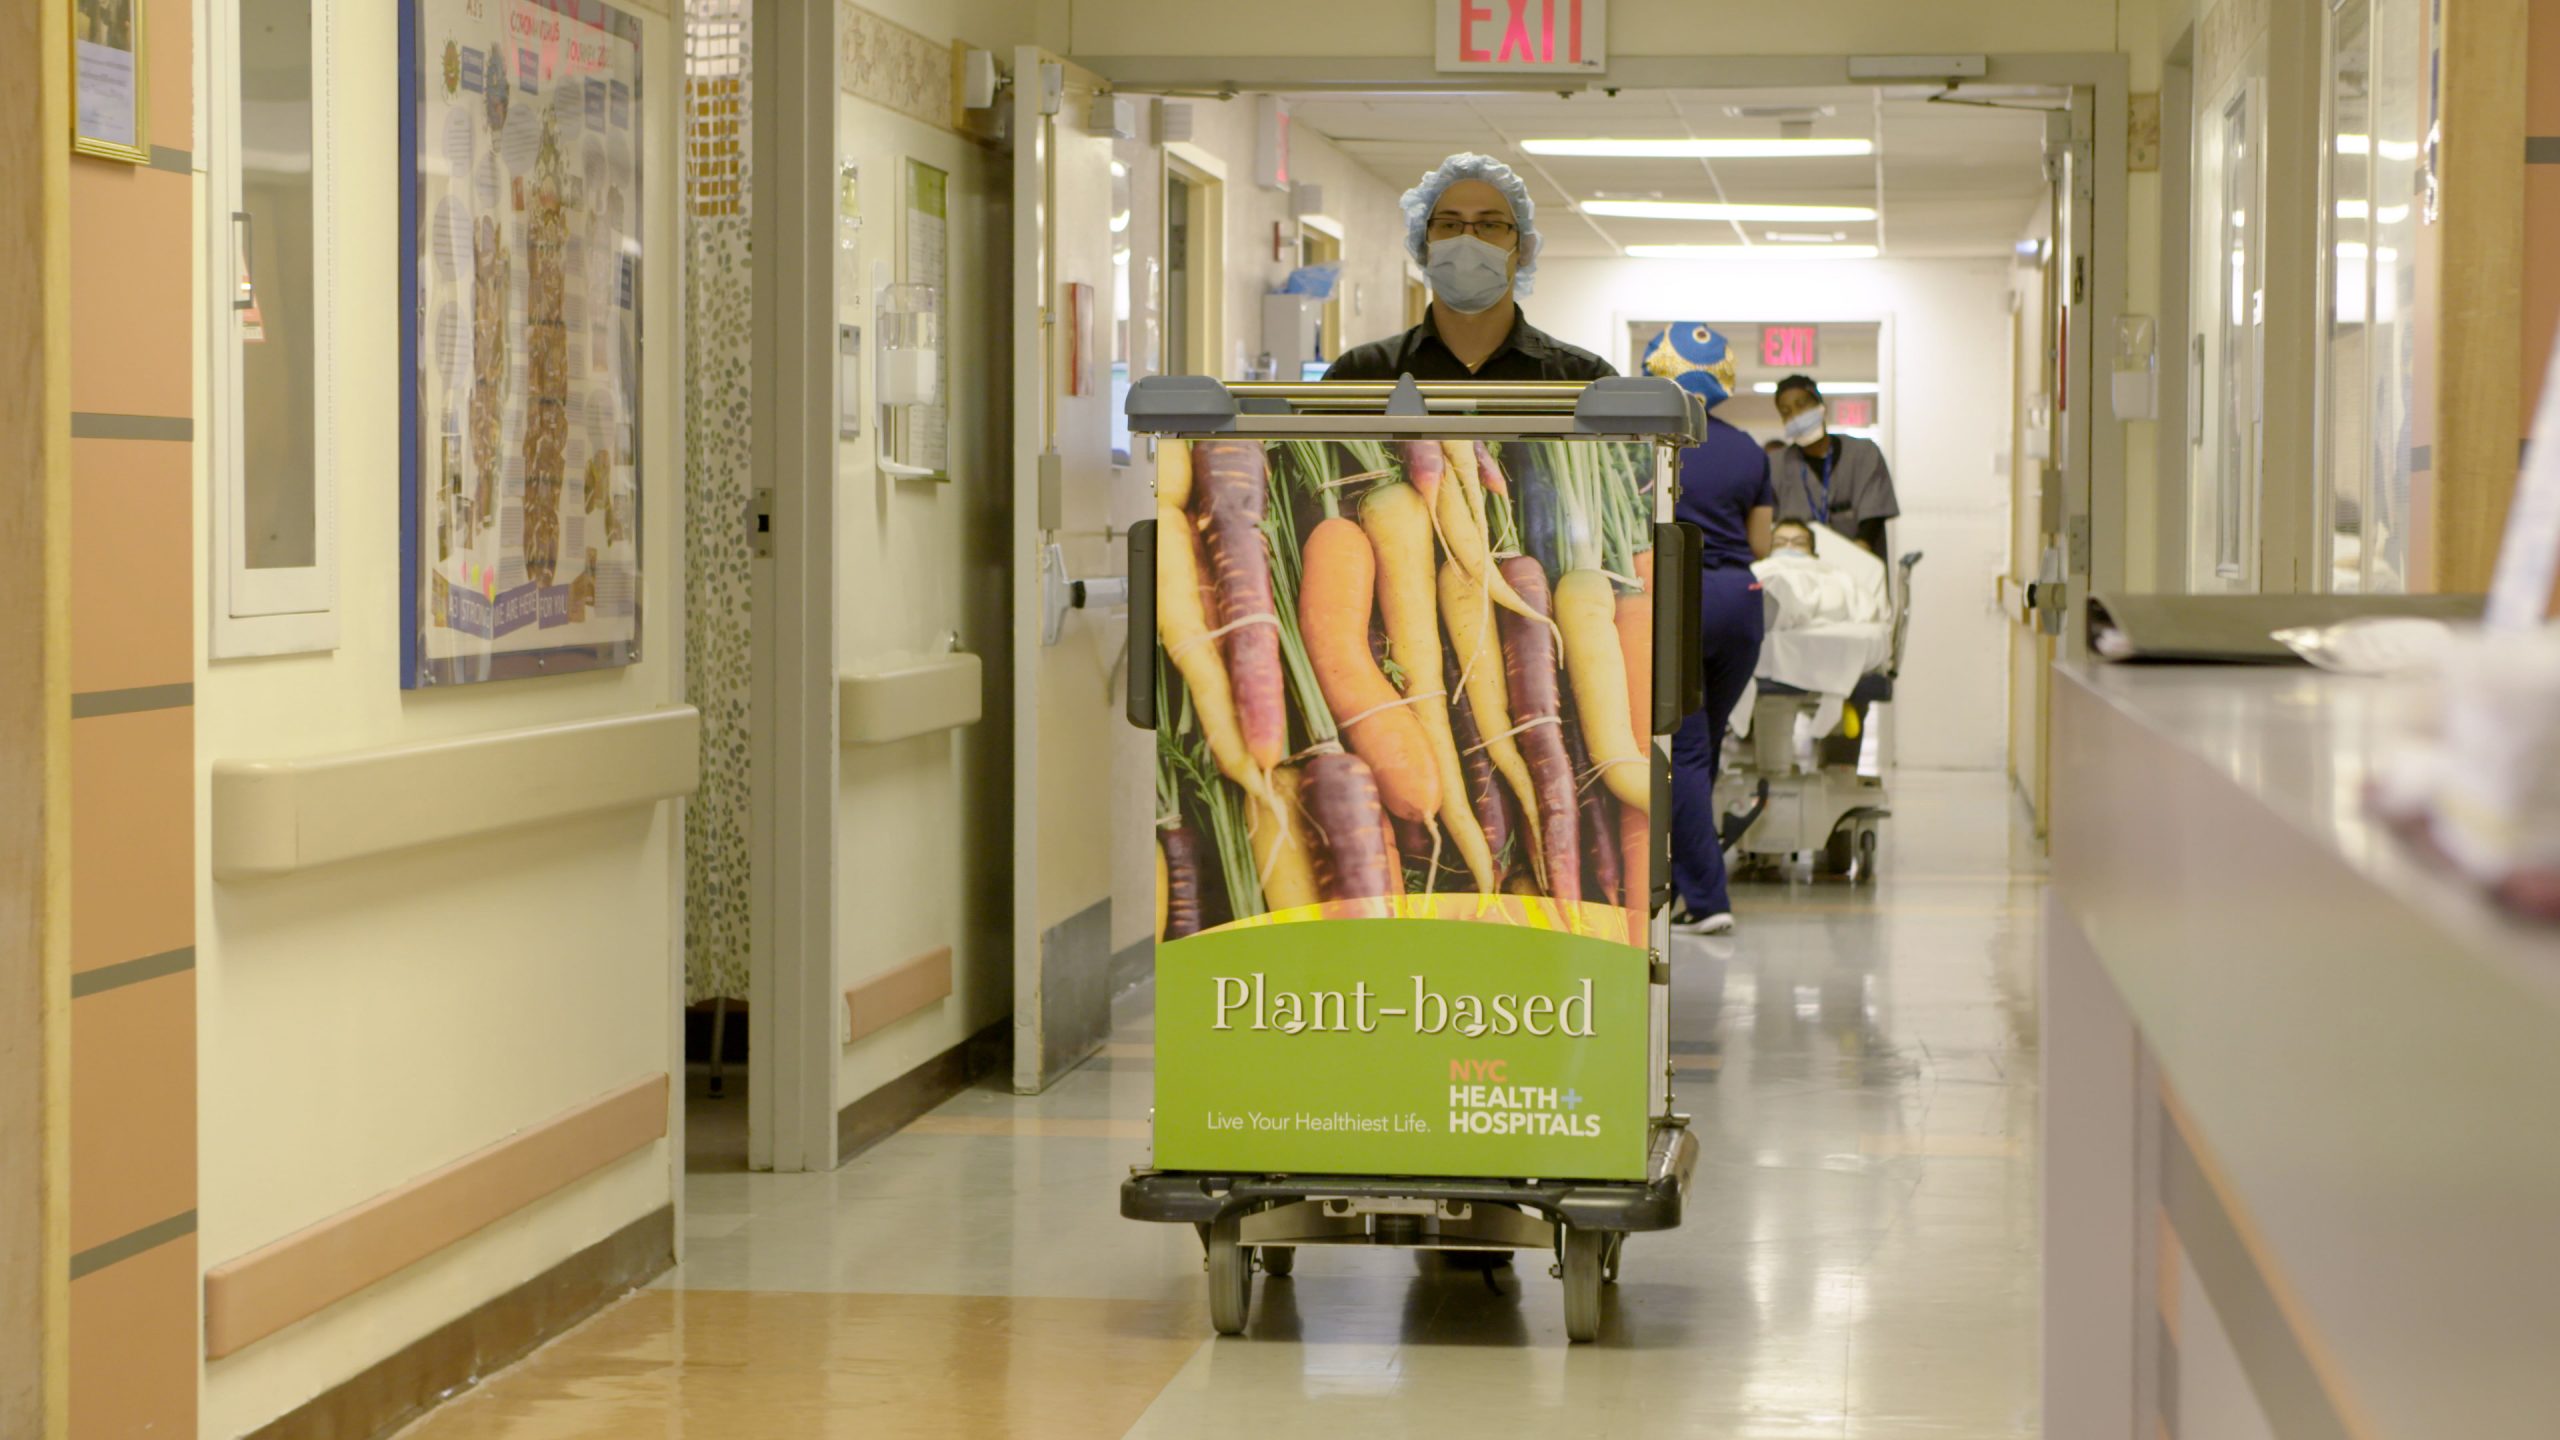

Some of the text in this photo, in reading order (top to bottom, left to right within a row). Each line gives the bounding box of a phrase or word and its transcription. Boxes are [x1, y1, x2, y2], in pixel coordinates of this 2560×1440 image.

[1459, 0, 1582, 64] EXIT
[1763, 326, 1815, 367] EXIT
[1211, 972, 1597, 1038] Plant-based
[1450, 1058, 1508, 1083] NYC
[1207, 1111, 1431, 1134] Live Your Healthiest Life.
[1450, 1111, 1601, 1138] HOSPITALS
